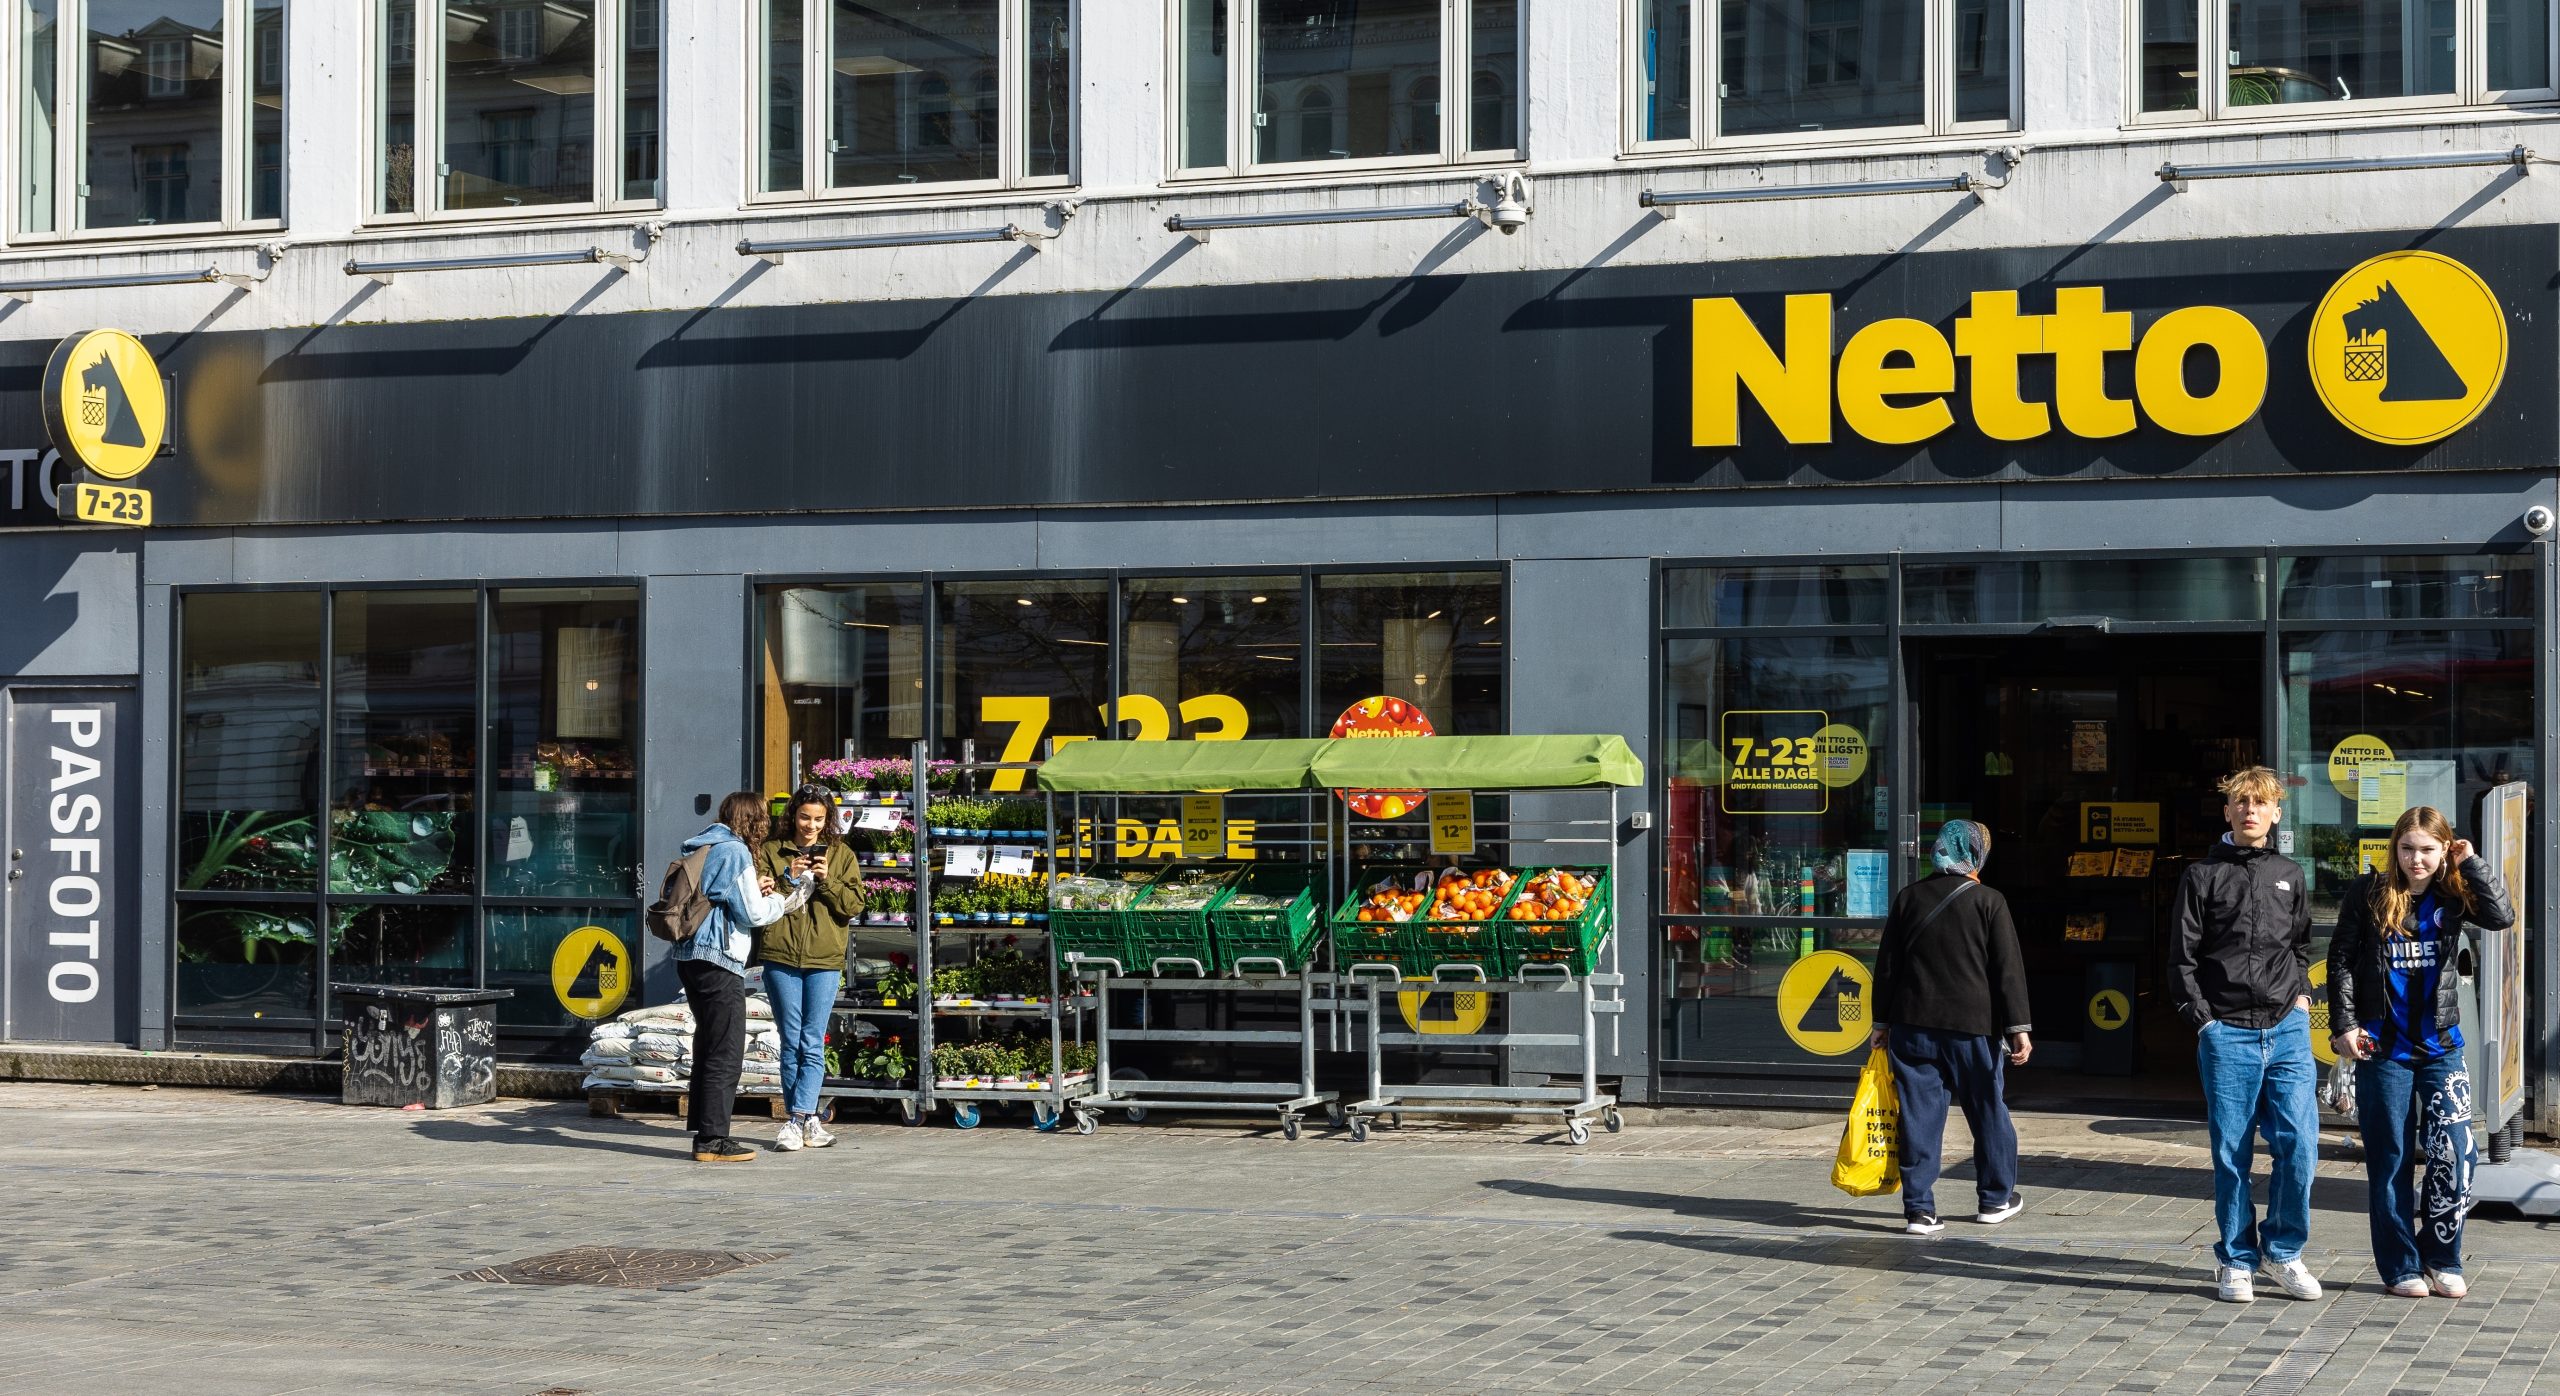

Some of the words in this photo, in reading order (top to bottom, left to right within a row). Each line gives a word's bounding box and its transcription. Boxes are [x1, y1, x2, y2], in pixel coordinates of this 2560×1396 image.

[1692, 286, 2269, 447] Netto
[85, 488, 144, 521] 7-23
[1732, 737, 1817, 766] 7-23
[2340, 747, 2372, 755] NETTO
[1731, 767, 1771, 780] ALLE
[1774, 767, 1818, 780] DAGE
[1116, 818, 1256, 860] DAE
[47, 709, 102, 1004] PASFOTO
[2383, 940, 2442, 958] UNIBET
[1866, 1107, 1887, 1117] Her
[1866, 1121, 1896, 1132] type,
[1867, 1133, 1893, 1145] ikke
[1867, 1146, 1886, 1158] for
